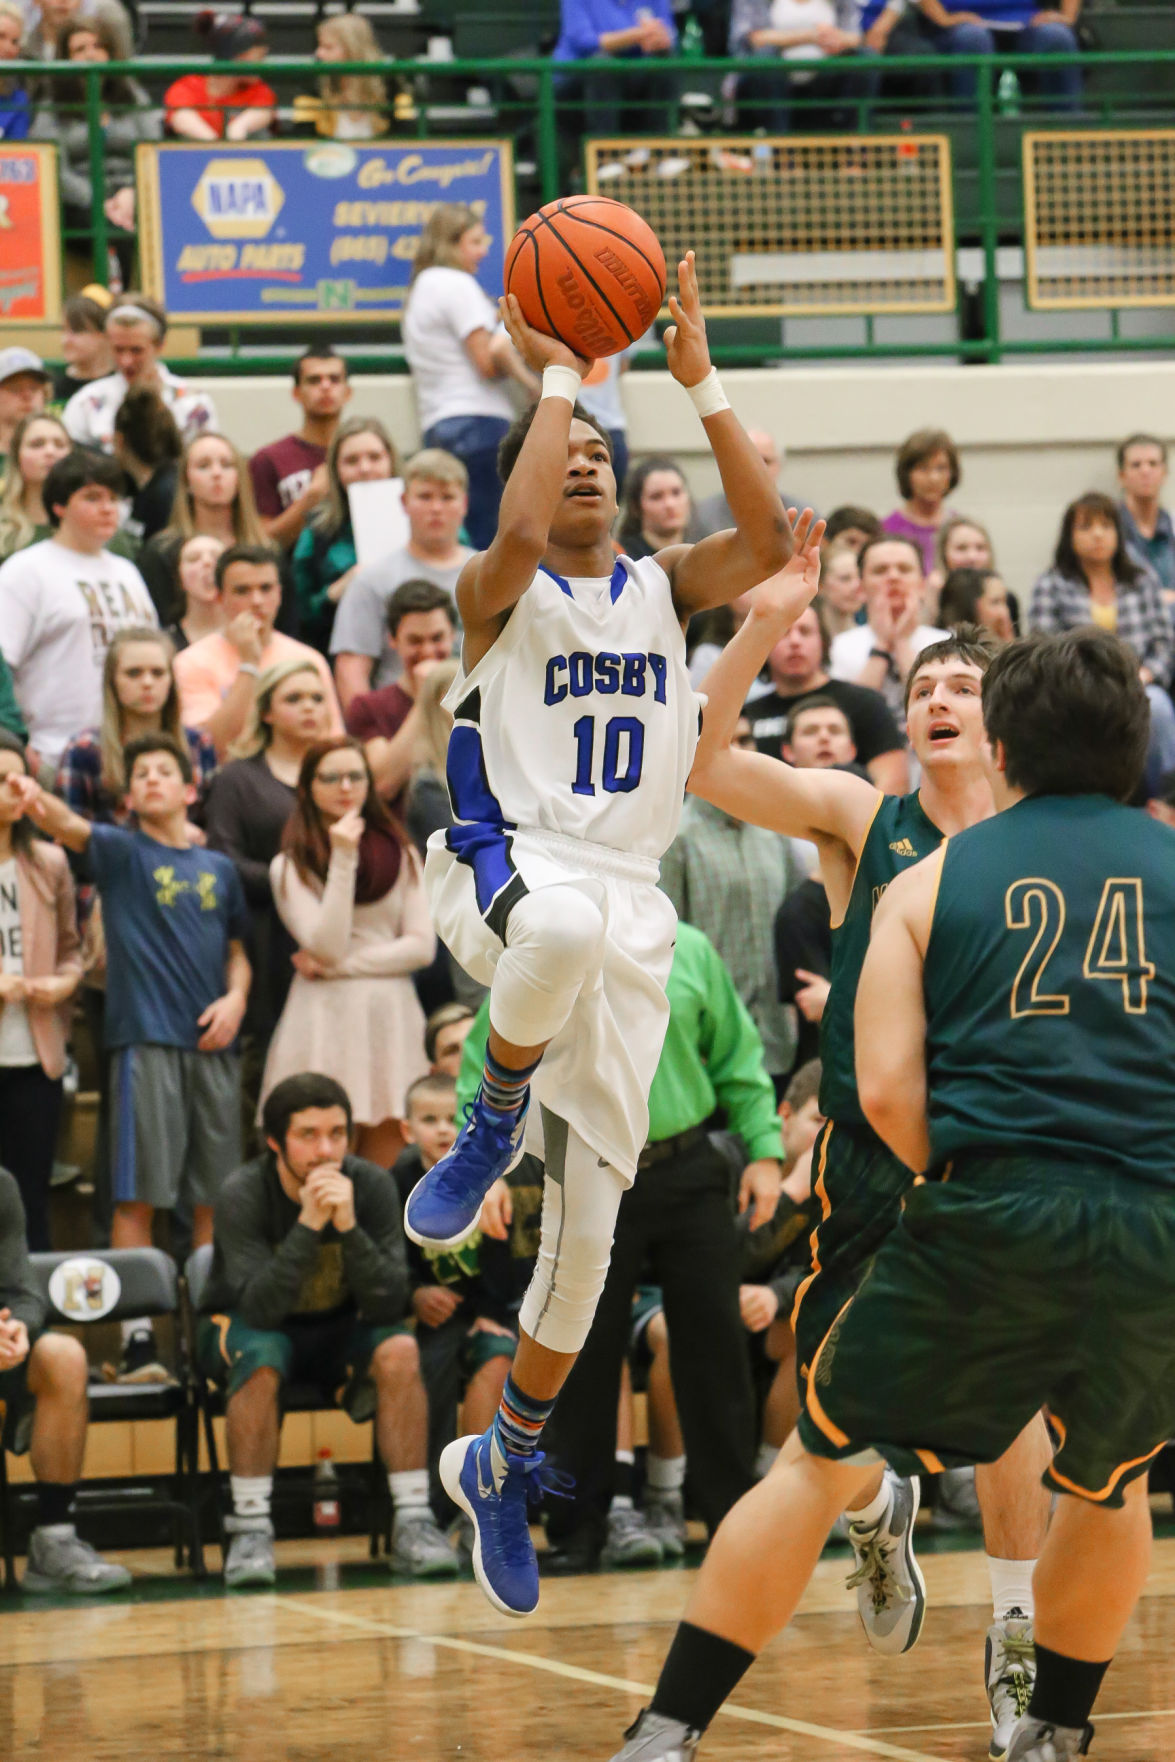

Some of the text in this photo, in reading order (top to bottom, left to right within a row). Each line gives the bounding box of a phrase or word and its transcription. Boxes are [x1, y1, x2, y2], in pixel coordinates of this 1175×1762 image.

[209, 182, 268, 215] NAPA
[176, 242, 306, 271] AUTO PARTS
[556, 270, 619, 354] Wilson
[544, 651, 667, 706] COSBY
[571, 715, 645, 796] 10
[1005, 877, 1155, 1019] 24
